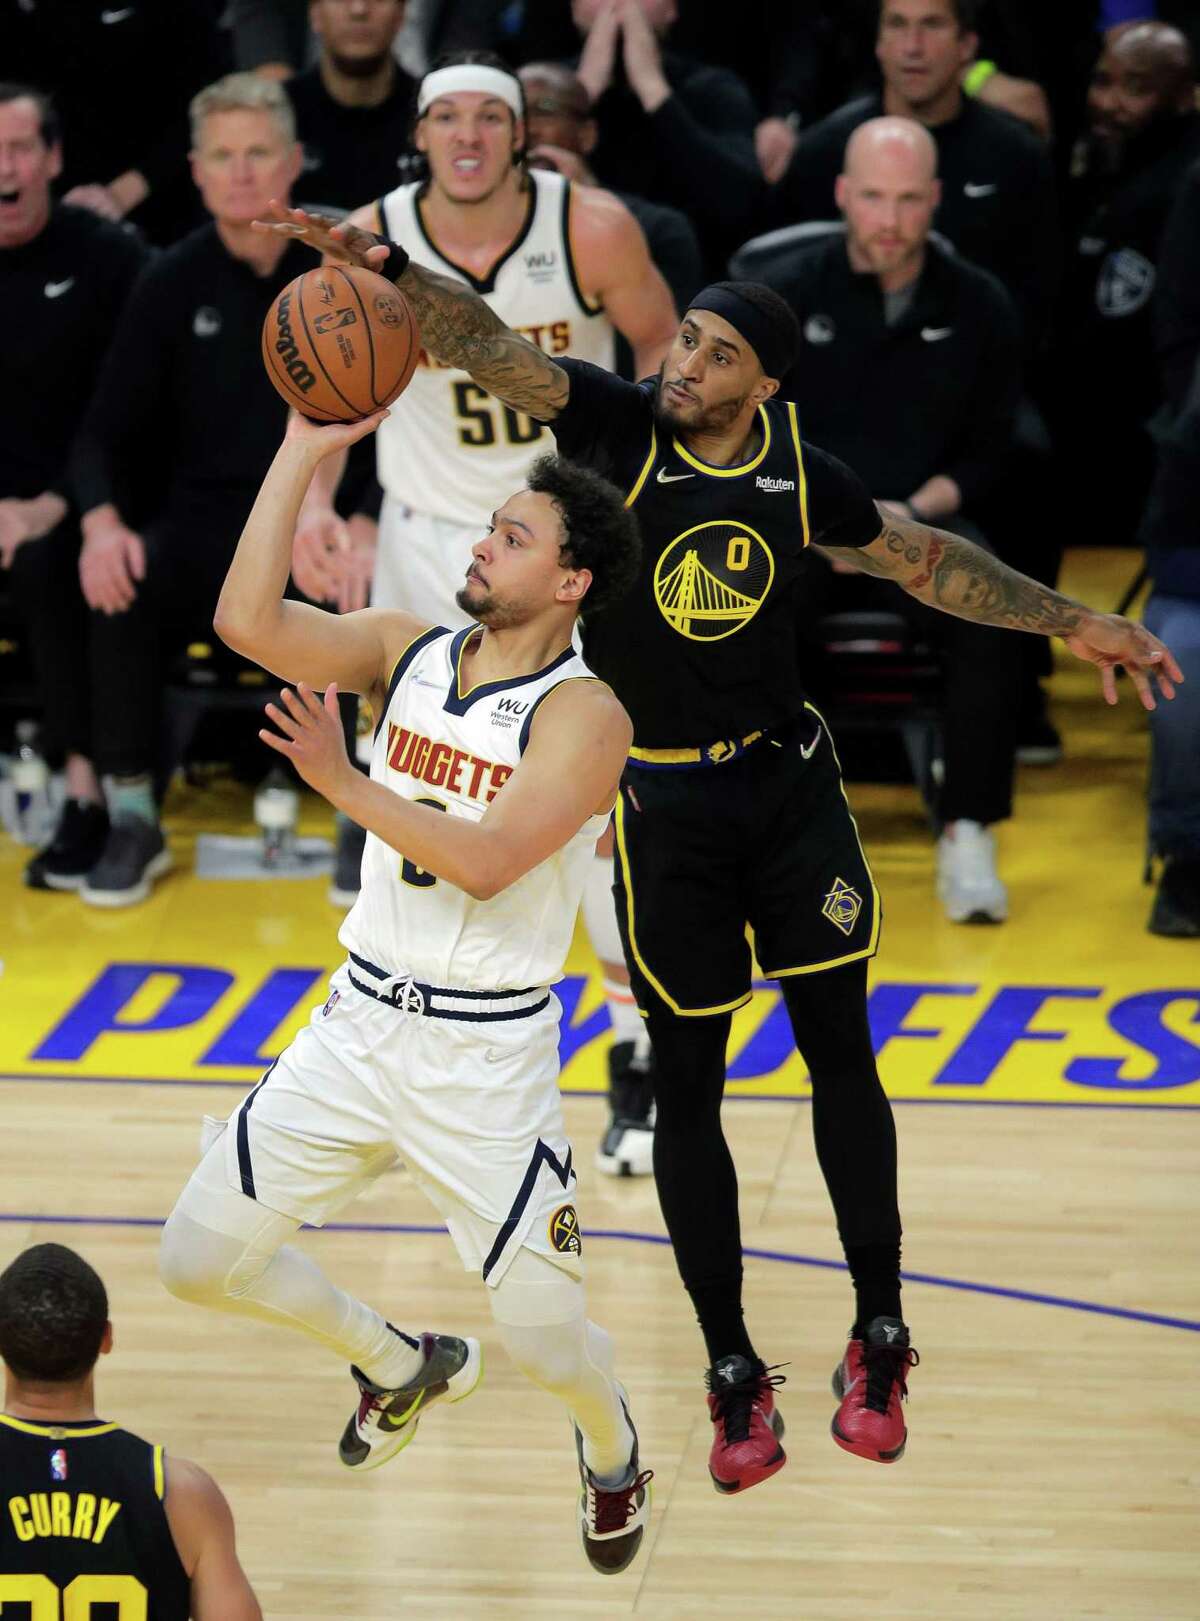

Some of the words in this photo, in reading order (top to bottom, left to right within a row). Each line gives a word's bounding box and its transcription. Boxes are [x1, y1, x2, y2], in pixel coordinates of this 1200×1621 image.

[525, 252, 556, 269] WU
[755, 475, 795, 492] Rakuten
[726, 536, 751, 572] 0
[497, 697, 529, 715] WU
[490, 711, 519, 724] Western
[490, 719, 512, 728] Union
[8, 1491, 122, 1545] CURRY
